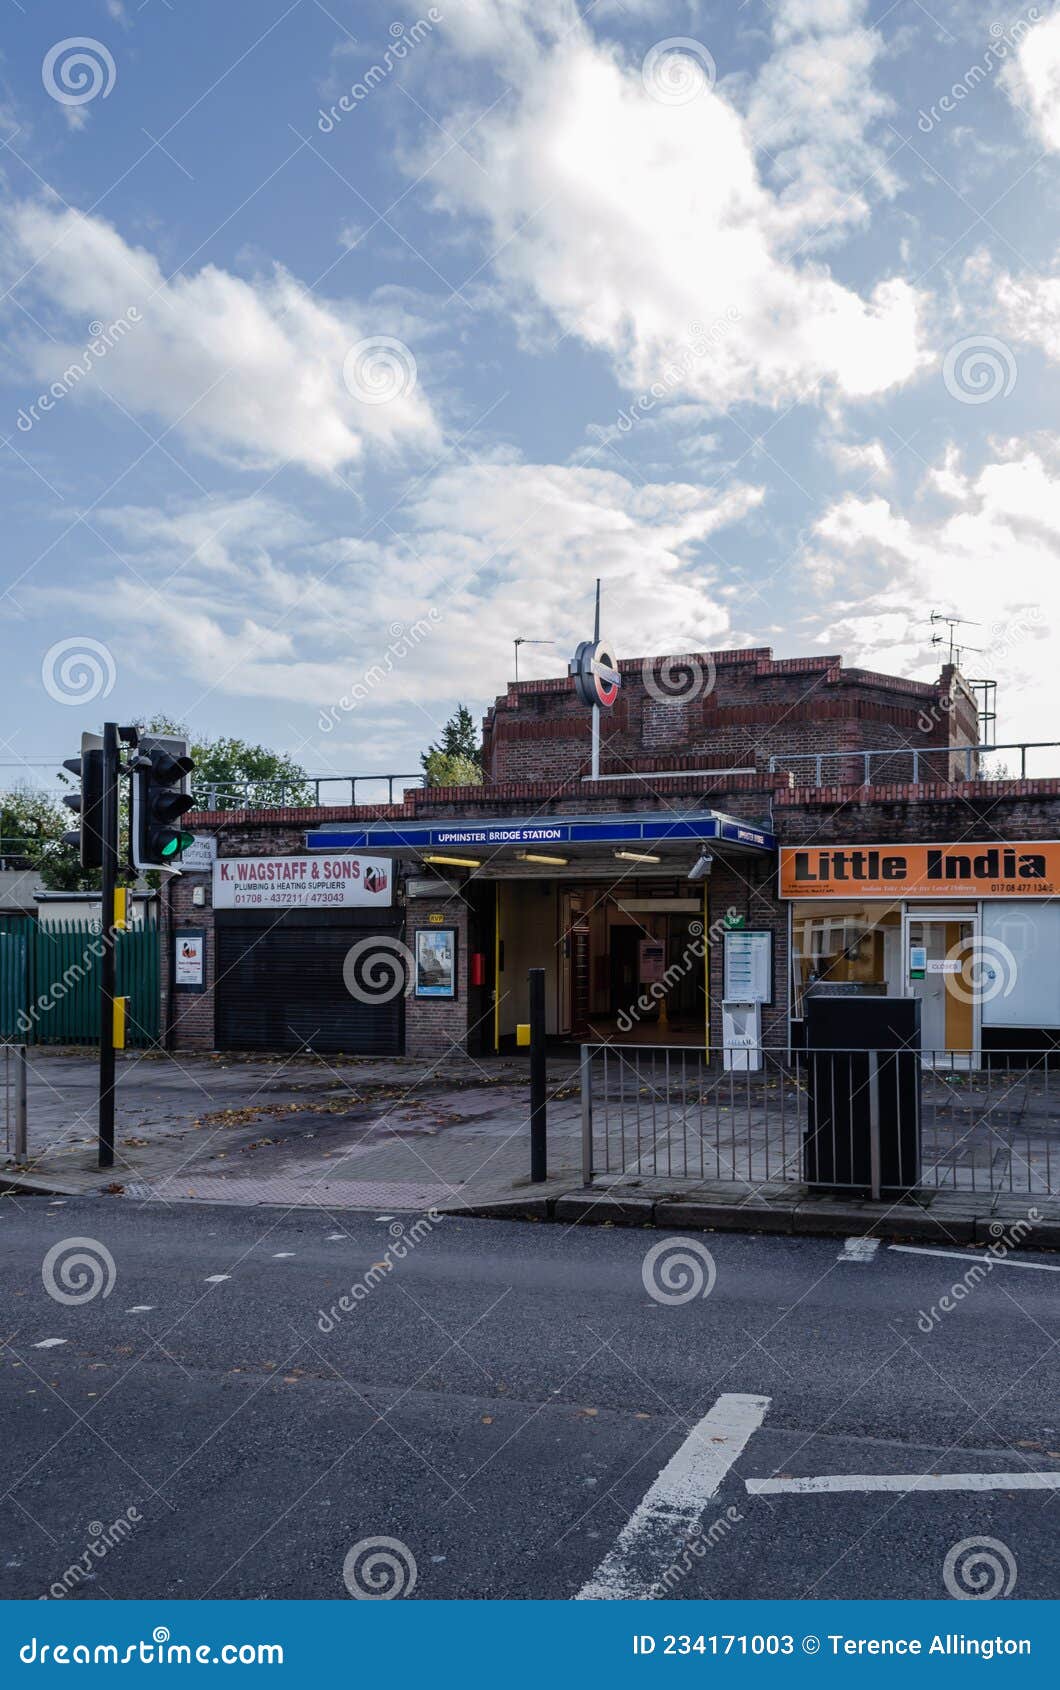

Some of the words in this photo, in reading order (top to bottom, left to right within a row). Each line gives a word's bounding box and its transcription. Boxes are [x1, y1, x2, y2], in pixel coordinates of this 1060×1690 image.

[438, 833, 486, 842] UPMINSTER
[489, 831, 521, 841] BRIDGE
[522, 830, 561, 840] STATION
[220, 863, 234, 881] K.
[237, 861, 307, 881] WAGSTAFF
[311, 862, 320, 879] &
[324, 860, 360, 879] SONS
[795, 851, 907, 881] Little
[927, 849, 1046, 879] India
[234, 882, 270, 891] PLUMBING
[271, 882, 275, 890] &
[277, 882, 306, 890] HEATING
[308, 881, 346, 890] SUPPLIERS
[235, 894, 262, 904] 01708
[270, 893, 301, 903] 437211
[311, 893, 344, 903] 473043
